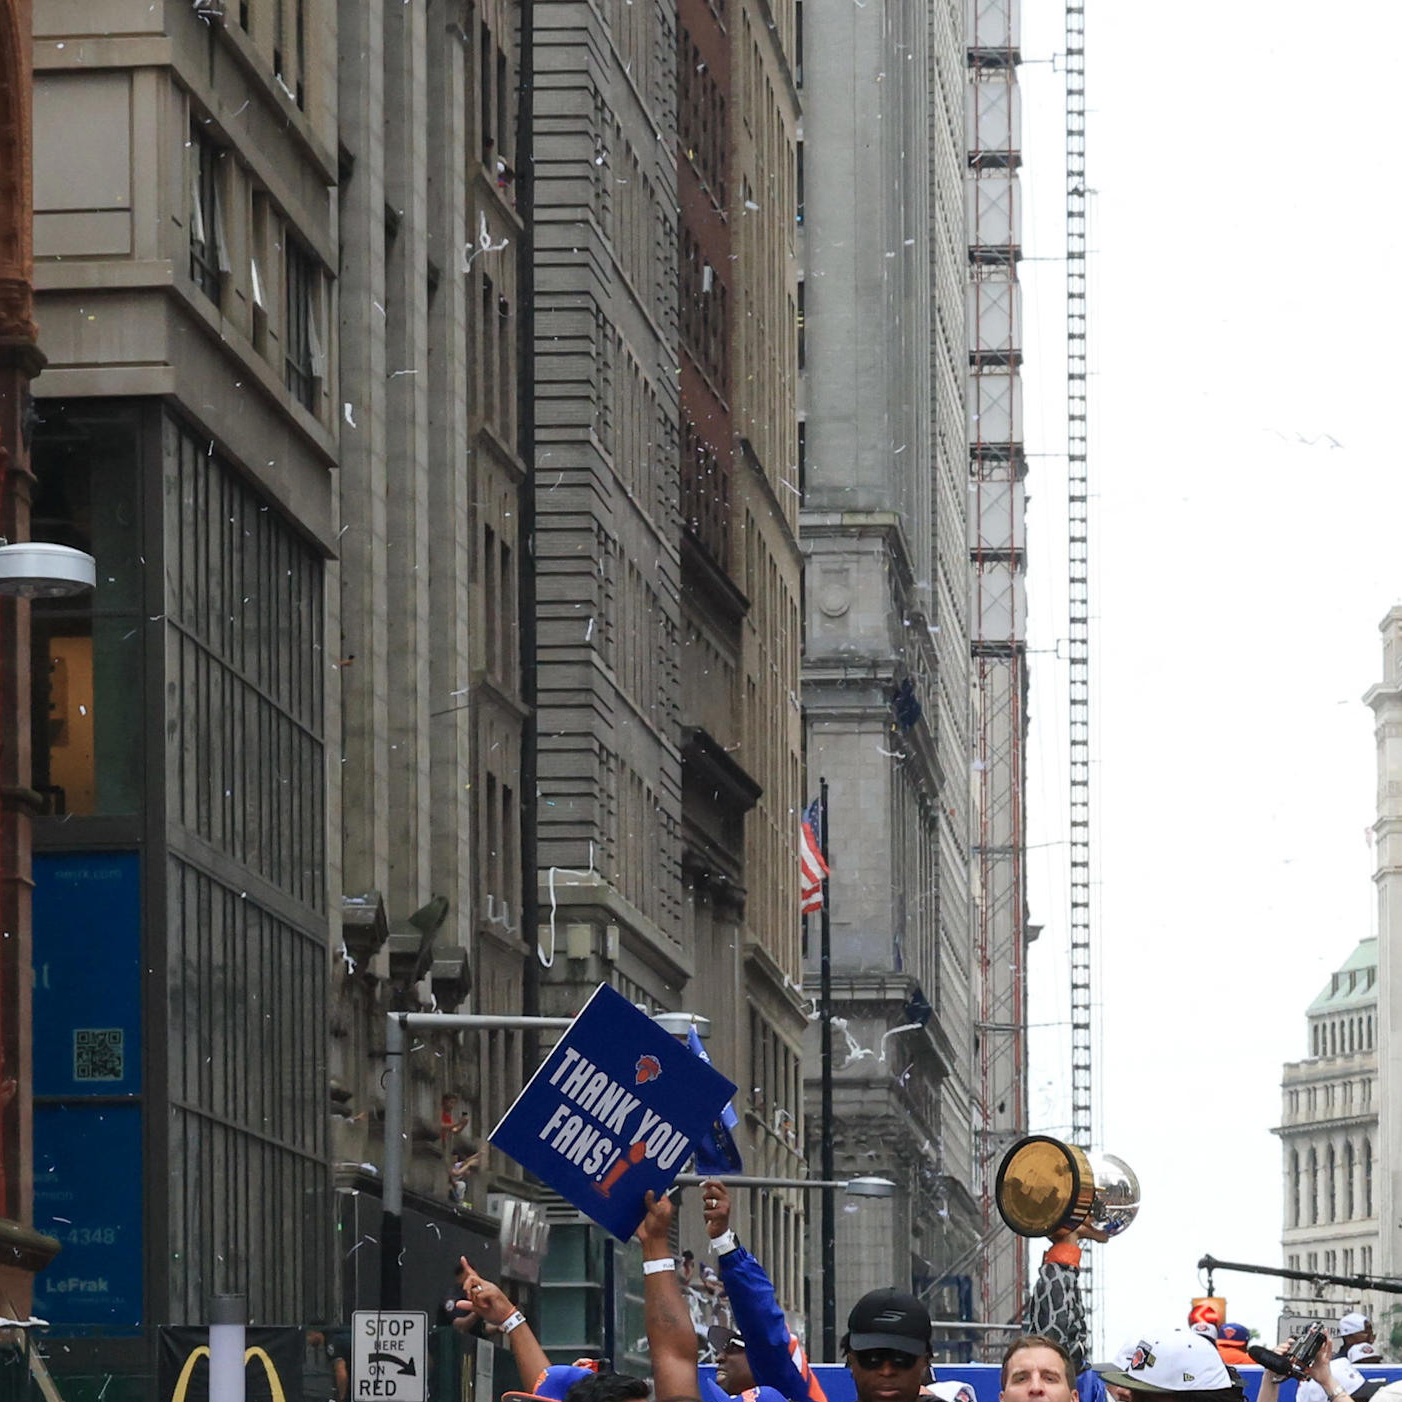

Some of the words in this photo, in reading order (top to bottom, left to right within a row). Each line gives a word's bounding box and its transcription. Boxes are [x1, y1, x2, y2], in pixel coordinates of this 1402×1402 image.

[549, 1046, 642, 1136] THANK
[629, 1108, 690, 1170] YOU
[538, 1103, 622, 1182] FANS!
[46, 1278, 109, 1293] LeFrak
[365, 1320, 414, 1336] STOP
[374, 1340, 405, 1351] HERE
[369, 1366, 385, 1375] ON
[360, 1380, 397, 1396] RED
